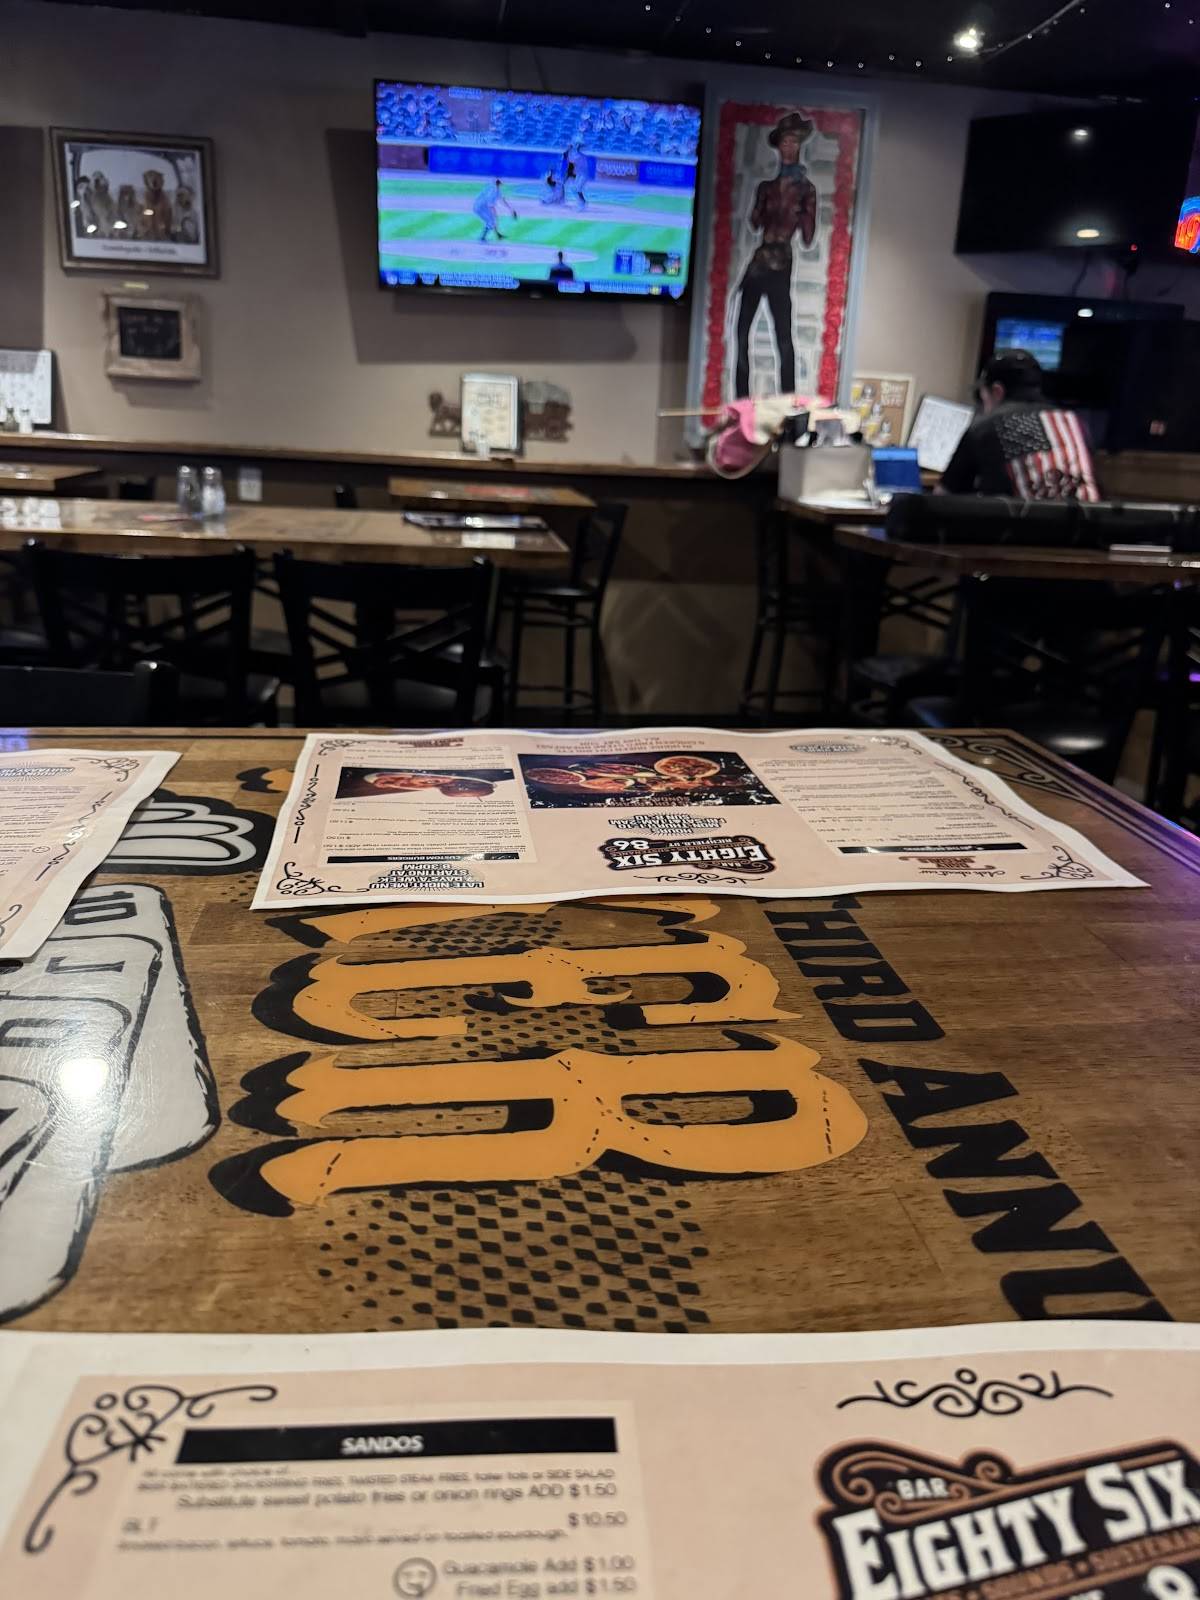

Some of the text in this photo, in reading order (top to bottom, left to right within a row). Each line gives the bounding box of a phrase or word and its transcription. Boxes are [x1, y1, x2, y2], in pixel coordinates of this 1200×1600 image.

[613, 840, 649, 850] 86
[612, 845, 767, 868] EIGHTY SIX
[858, 1058, 1175, 1321] ANNU
[342, 1435, 424, 1456] SANDOS
[546, 1469, 573, 1479] SIDE
[575, 1468, 616, 1479] SALAD
[371, 1490, 405, 1502] fries
[410, 1491, 429, 1502] or
[434, 1488, 479, 1501] onion
[483, 1486, 523, 1503] rings
[528, 1484, 564, 1497] ADD
[896, 1478, 951, 1501] BAR
[832, 1486, 1088, 1600] EIGHTY
[1085, 1460, 1200, 1543] SIX
[443, 1558, 539, 1578] Guacamole
[544, 1557, 578, 1574] Add
[456, 1580, 501, 1597] Fried
[507, 1580, 541, 1600] Egg
[548, 1578, 578, 1595] add
